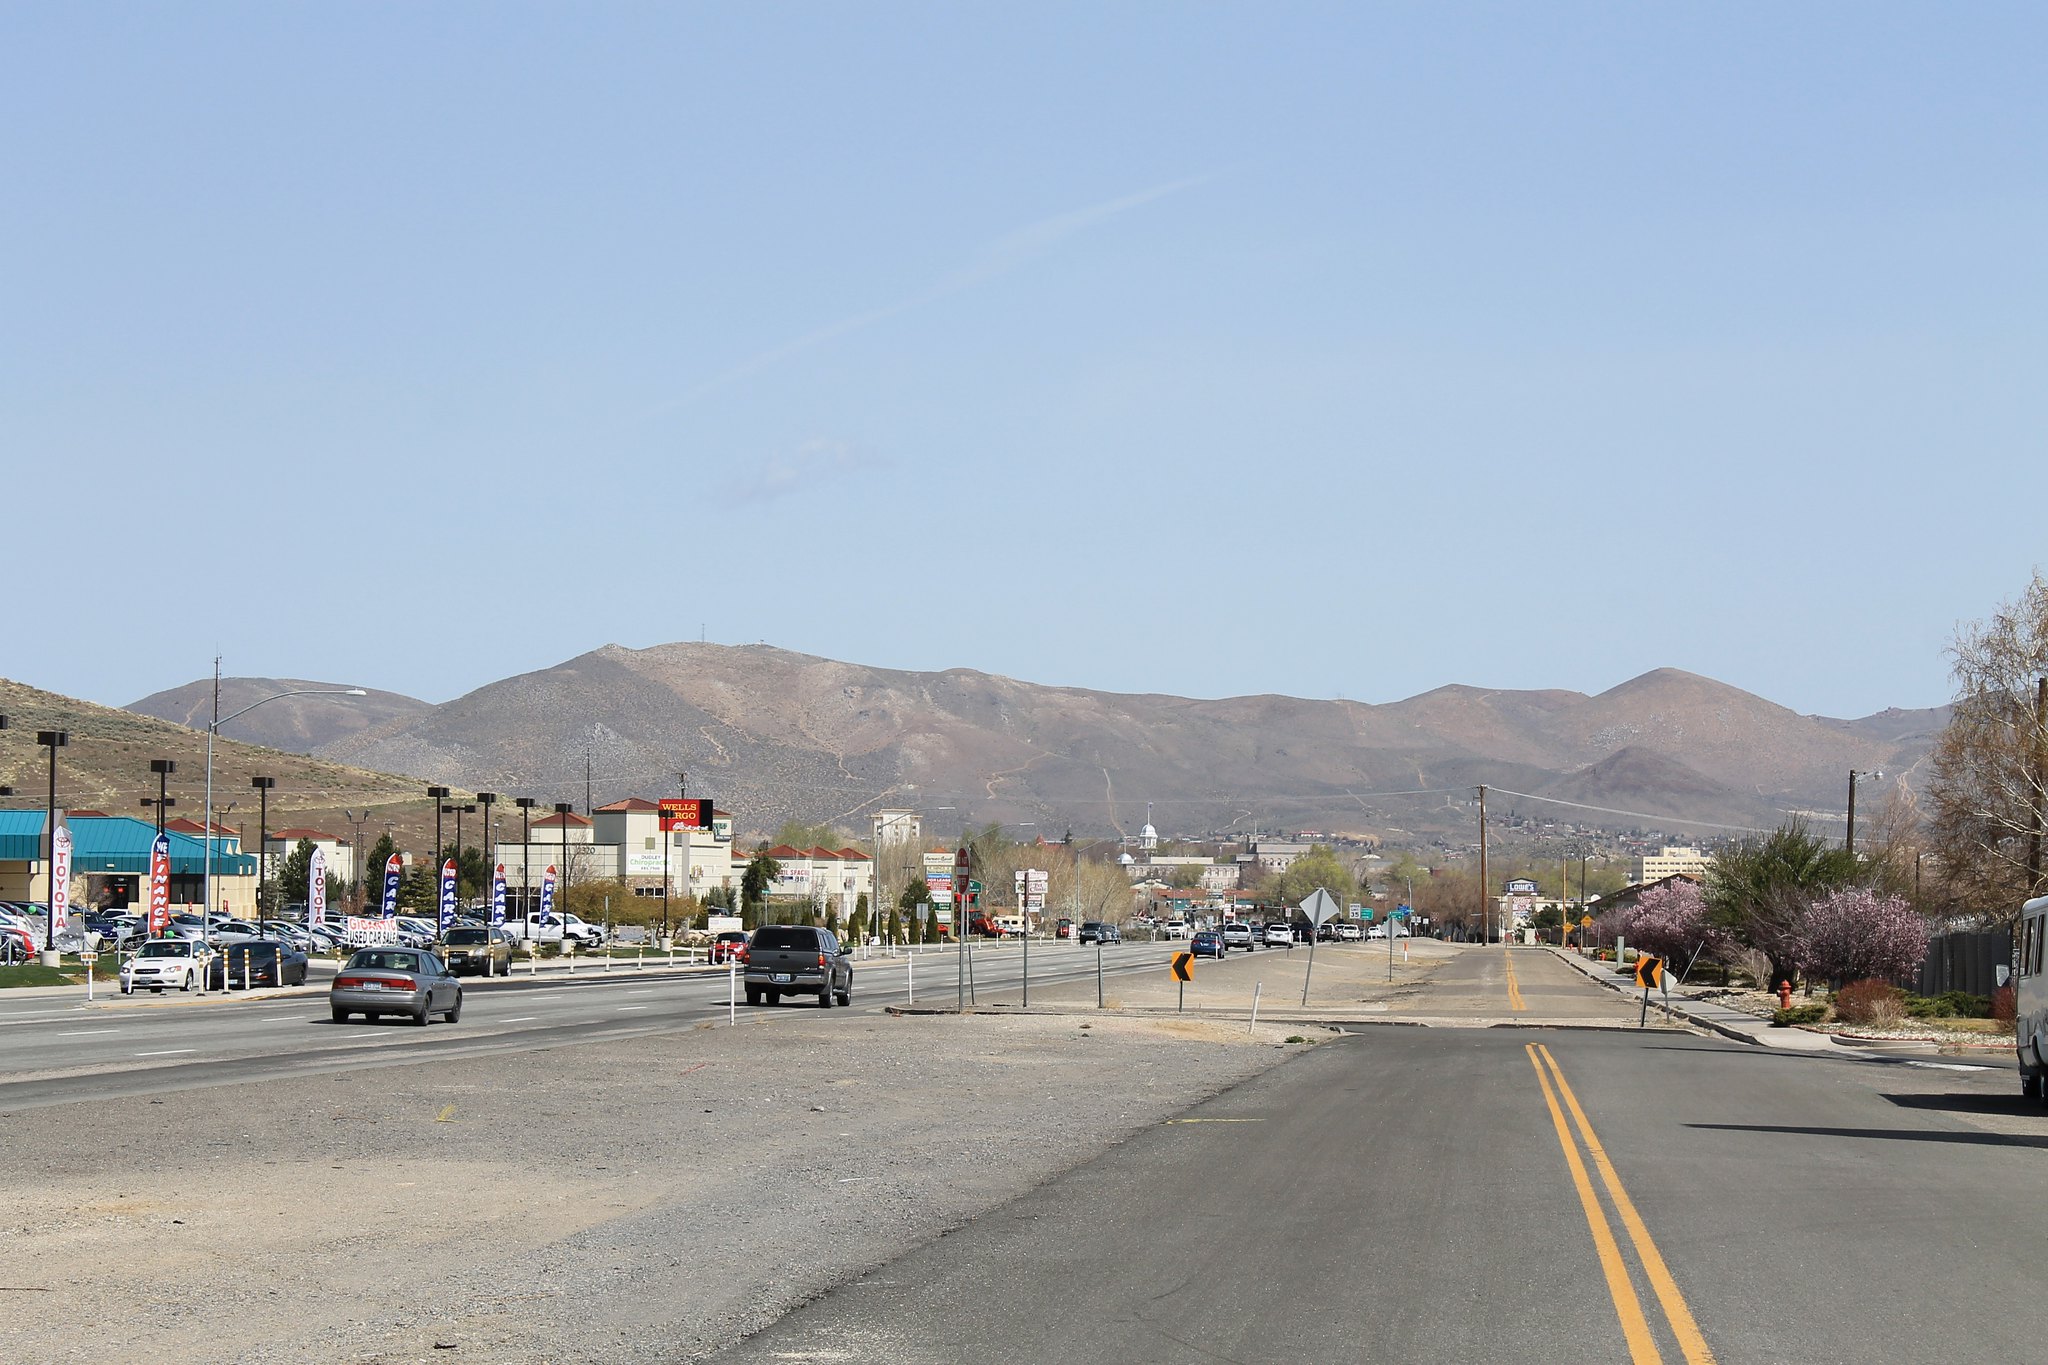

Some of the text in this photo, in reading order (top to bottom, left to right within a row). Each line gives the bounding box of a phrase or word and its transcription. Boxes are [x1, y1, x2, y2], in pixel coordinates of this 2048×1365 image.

[662, 803, 697, 811] WELLS
[156, 841, 168, 853] WE
[54, 852, 67, 928] TOYOTA
[153, 853, 168, 927] FINANCE
[314, 867, 325, 924] TOYOTA
[441, 880, 456, 925] CARS
[494, 882, 506, 926] CARS
[541, 883, 554, 924] CARS
[349, 917, 396, 931] GIGANTIC
[349, 930, 396, 945] USED CAR SALE
